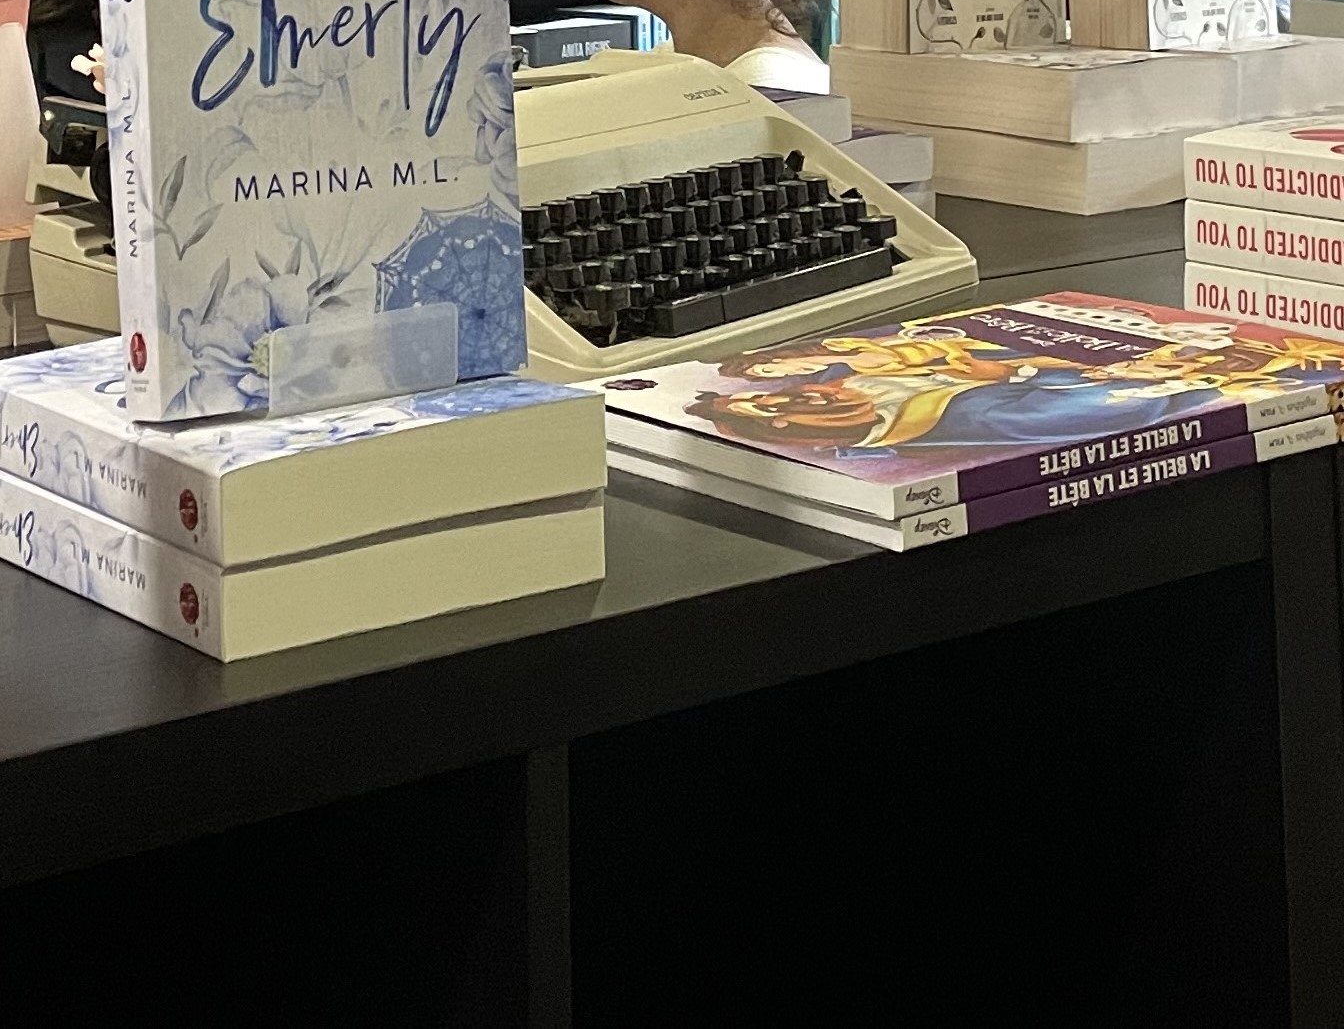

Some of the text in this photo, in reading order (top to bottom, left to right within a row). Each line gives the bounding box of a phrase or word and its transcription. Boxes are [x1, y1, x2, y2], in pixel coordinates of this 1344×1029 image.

[233, 158, 459, 204] MARINA M.L.
[1195, 158, 1231, 186] YOU
[1236, 162, 1257, 189] TO
[124, 149, 139, 259] MARINA
[1196, 220, 1231, 248] YOU
[1237, 225, 1258, 252] TO
[1196, 283, 1231, 312] YOU
[1238, 289, 1259, 317] TO
[1133, 424, 1179, 454] BELLE
[1182, 419, 1202, 441] LA
[1085, 442, 1107, 465] LA
[1109, 438, 1129, 460] ET
[1190, 450, 1211, 472] LA
[1040, 450, 1081, 476] BÊTE
[1142, 459, 1187, 485] BELLE
[99, 461, 147, 498] MARINA
[1094, 474, 1115, 497] LA
[1118, 467, 1139, 490] ET
[1049, 481, 1090, 508] BÊTE
[97, 553, 146, 590] MARINA
